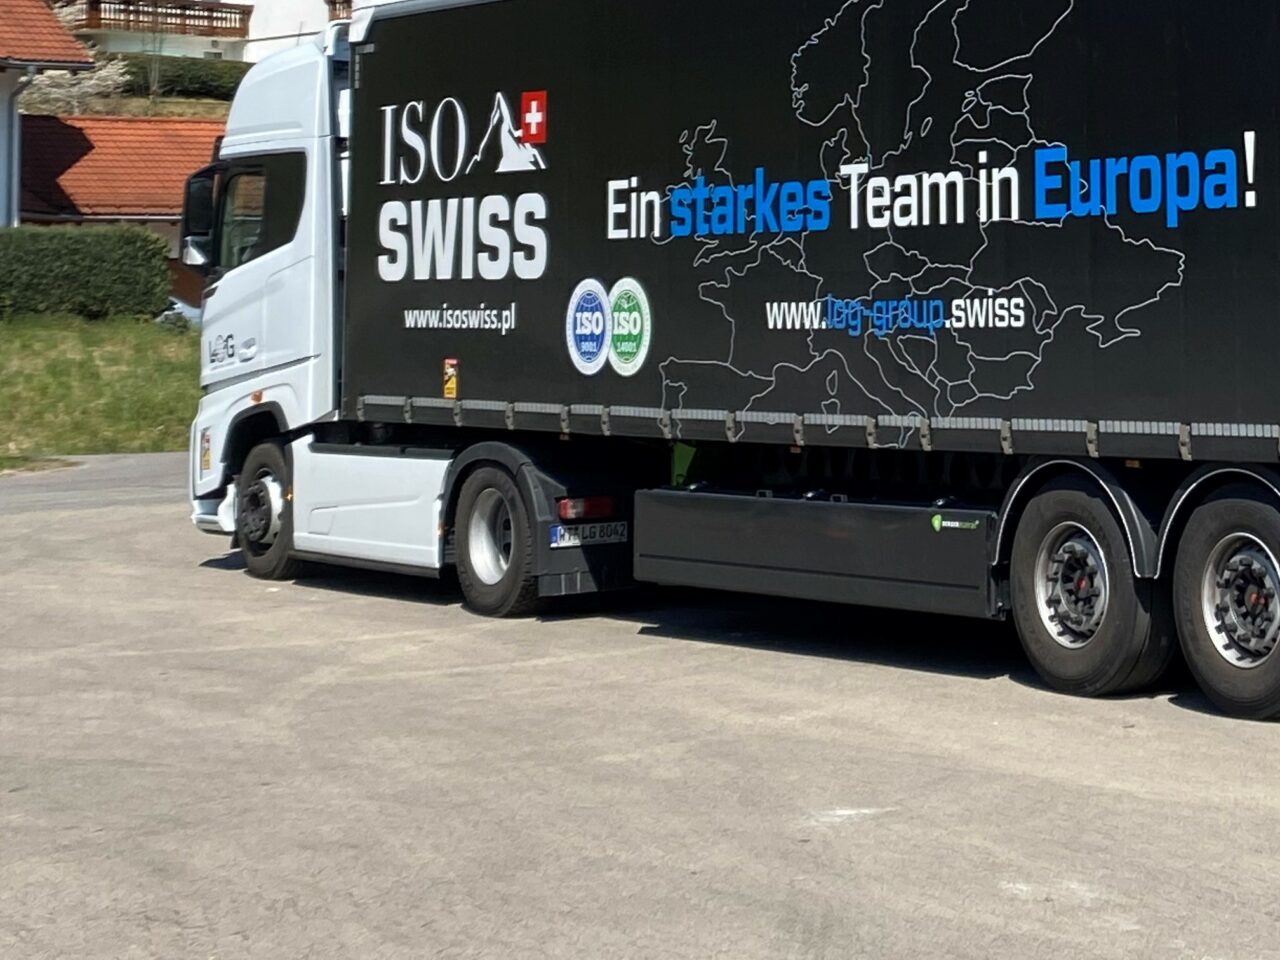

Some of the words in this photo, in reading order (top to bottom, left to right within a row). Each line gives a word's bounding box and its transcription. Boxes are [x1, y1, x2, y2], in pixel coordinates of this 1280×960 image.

[378, 97, 466, 185] ISO
[607, 176, 660, 239] Ein
[670, 167, 831, 238] starkes
[840, 162, 964, 230] Team
[978, 150, 1019, 222] in
[1033, 130, 1256, 228] Europa!
[377, 192, 548, 282] SWISS
[403, 302, 516, 336] www.isoswiss.pl
[575, 311, 604, 335] ISO
[612, 311, 641, 335] ISO
[766, 288, 1025, 337] www.log-group.swiss
[581, 526, 597, 540] LG
